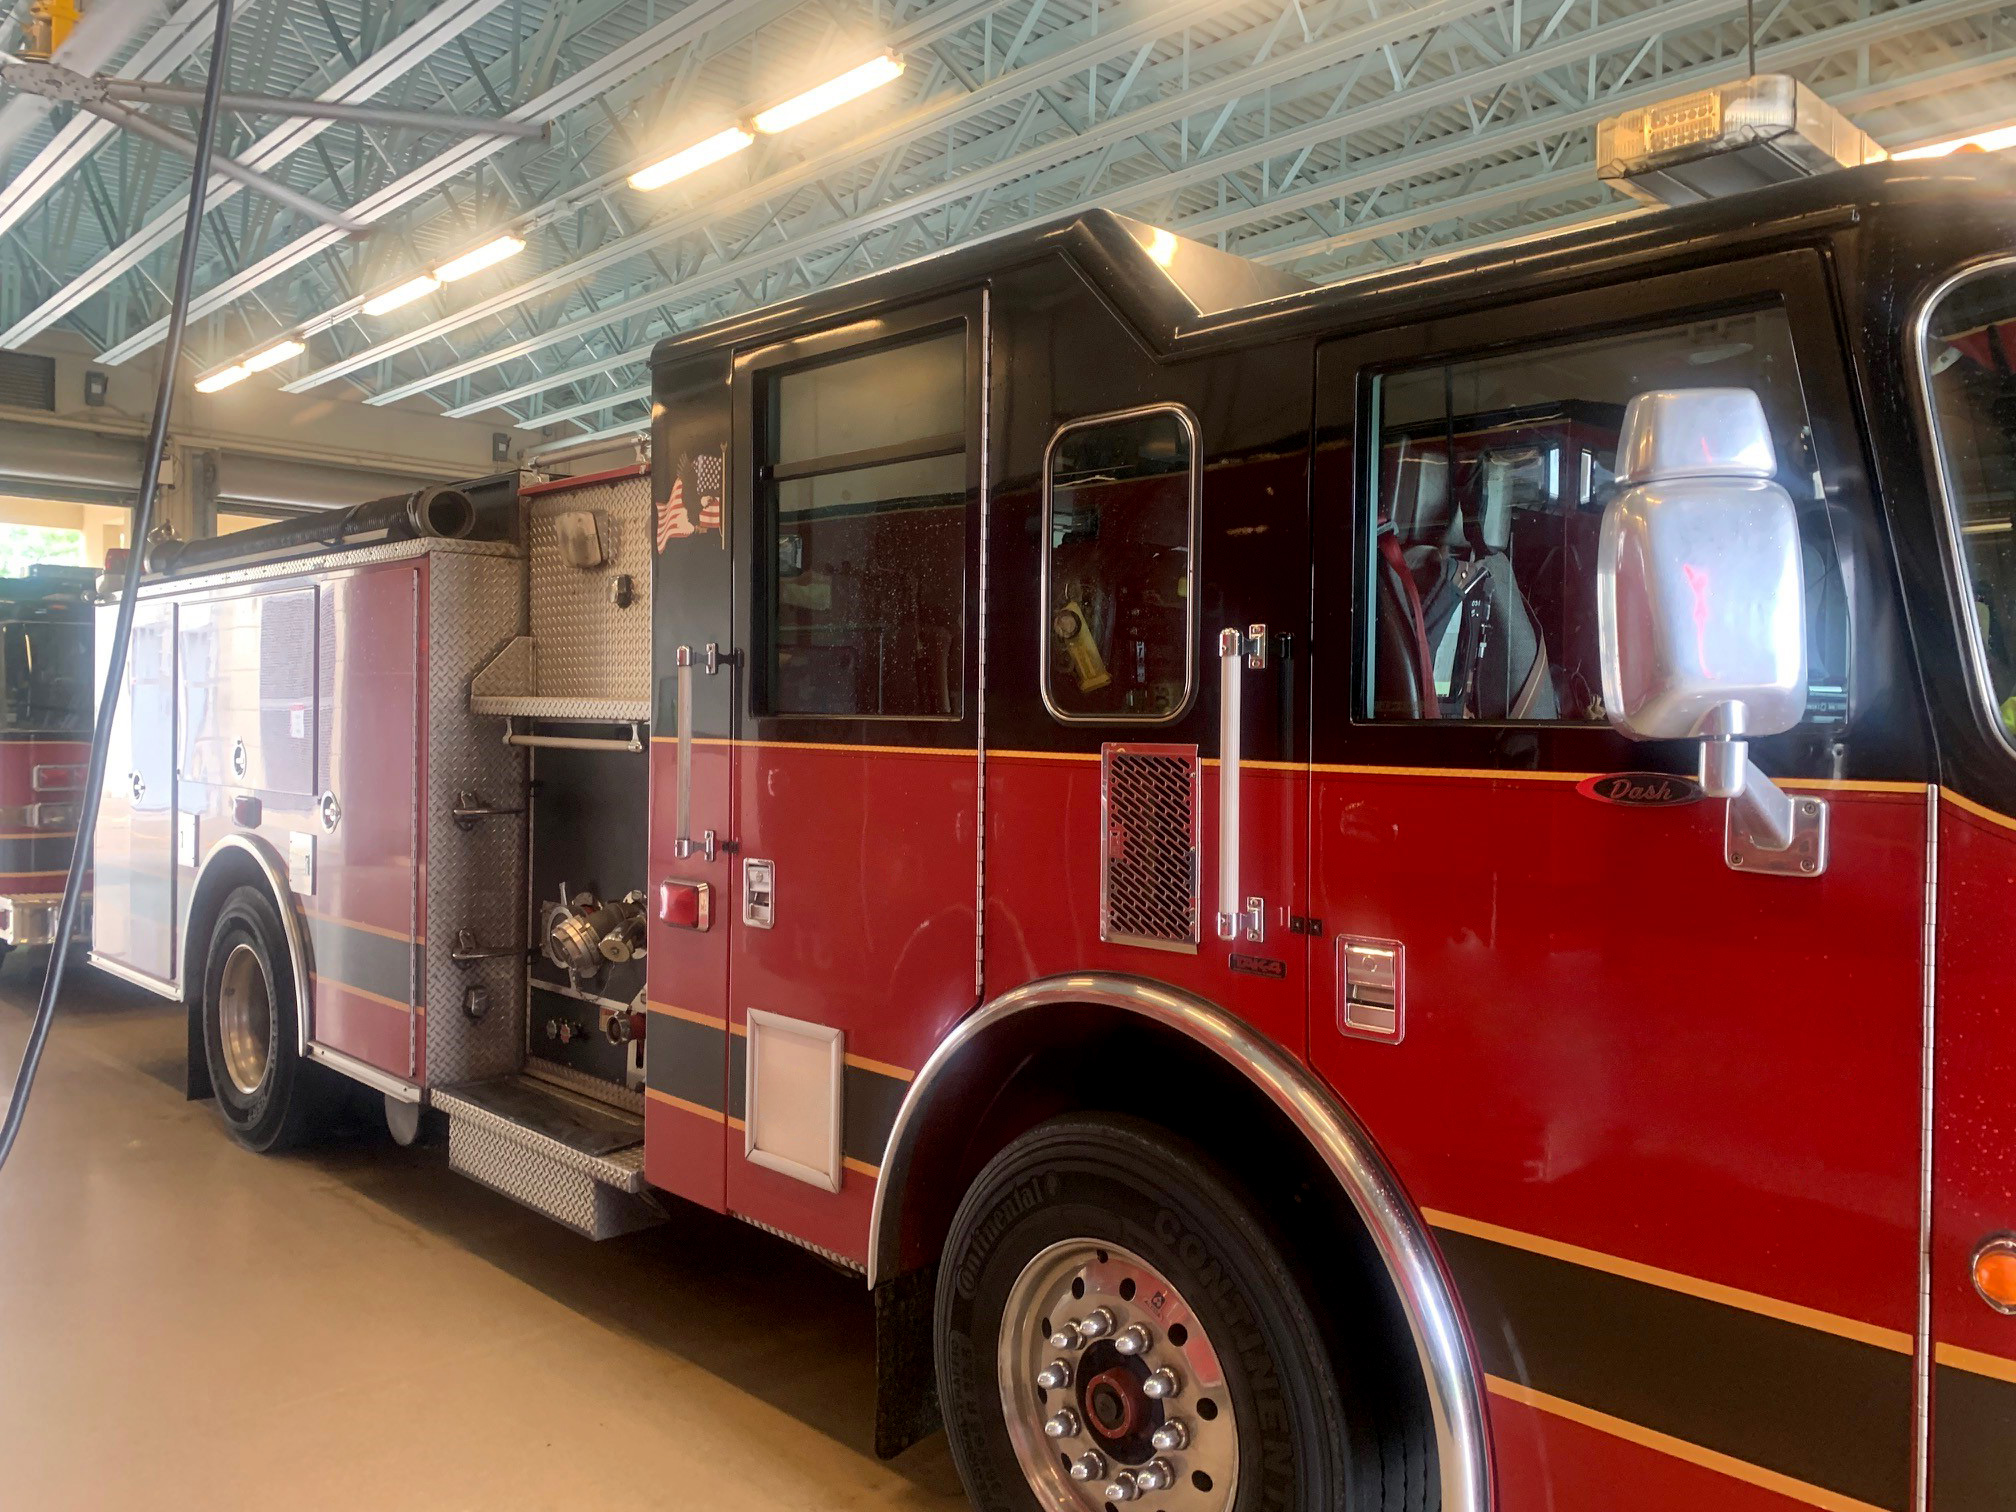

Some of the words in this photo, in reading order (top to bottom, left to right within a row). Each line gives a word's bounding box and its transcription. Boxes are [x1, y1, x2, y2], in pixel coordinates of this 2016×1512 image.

[1610, 779, 1672, 800] Dash
[955, 1177, 1044, 1299] Continental
[1155, 1209, 1296, 1512] CONTINENT
